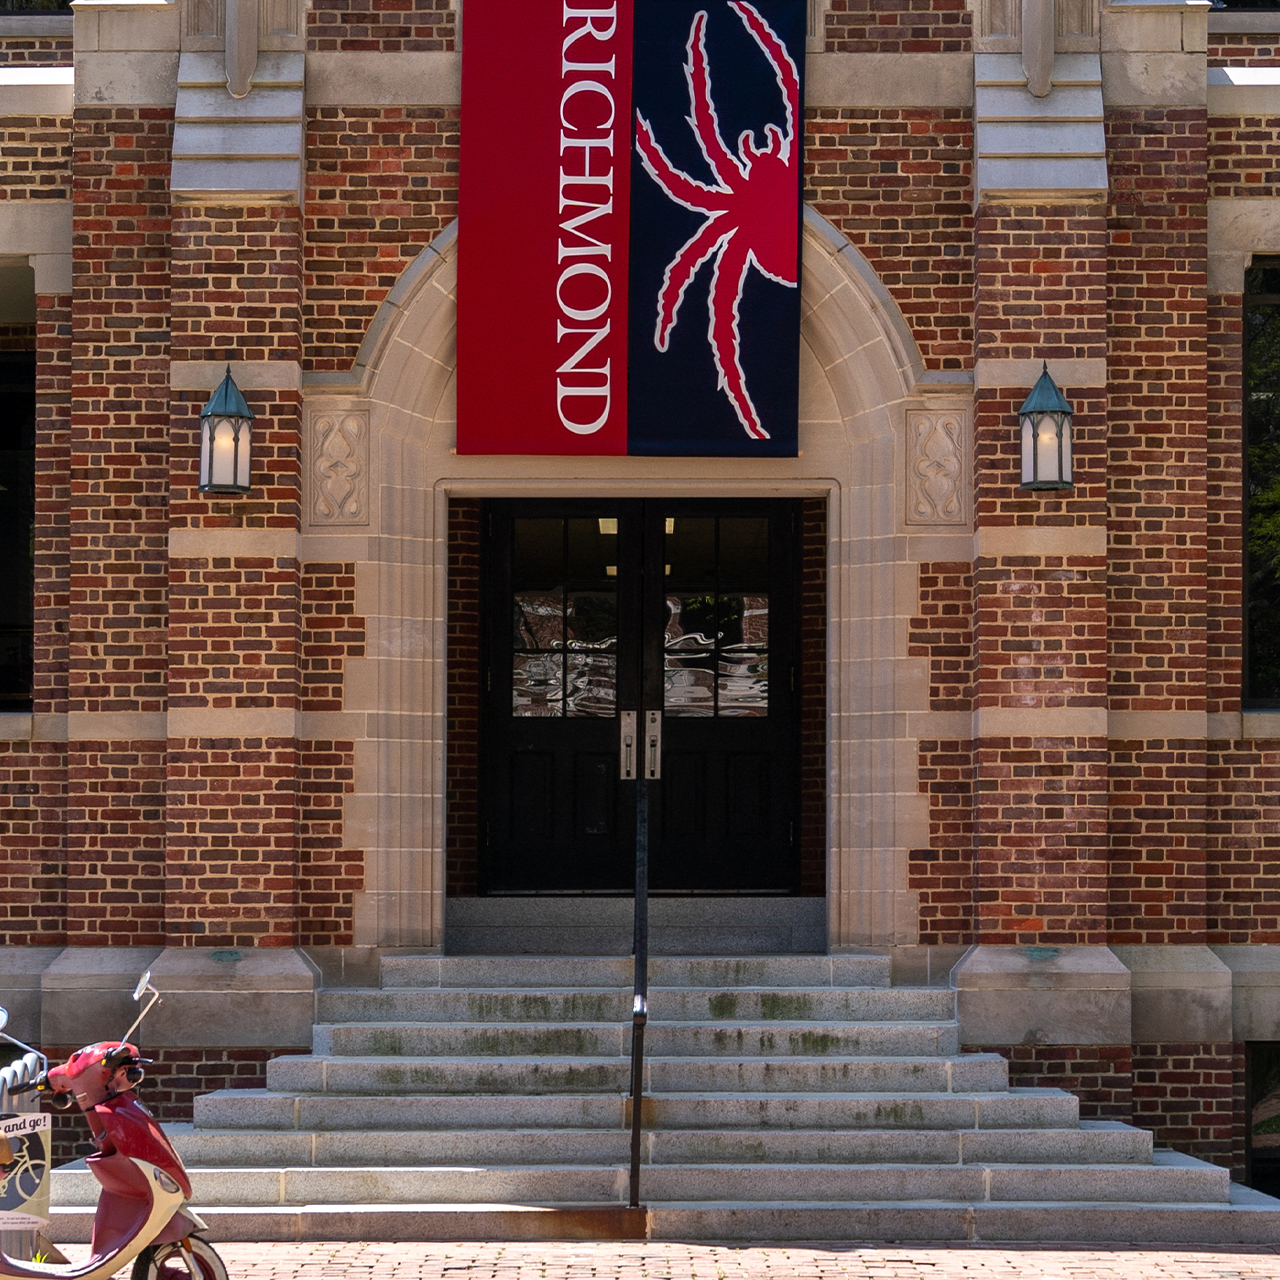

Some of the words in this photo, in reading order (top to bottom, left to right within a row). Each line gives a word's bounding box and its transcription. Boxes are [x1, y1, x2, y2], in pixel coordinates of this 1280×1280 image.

[556, 0, 617, 435] RICHMOND
[4, 1119, 27, 1133] and
[29, 1116, 47, 1131] go!
